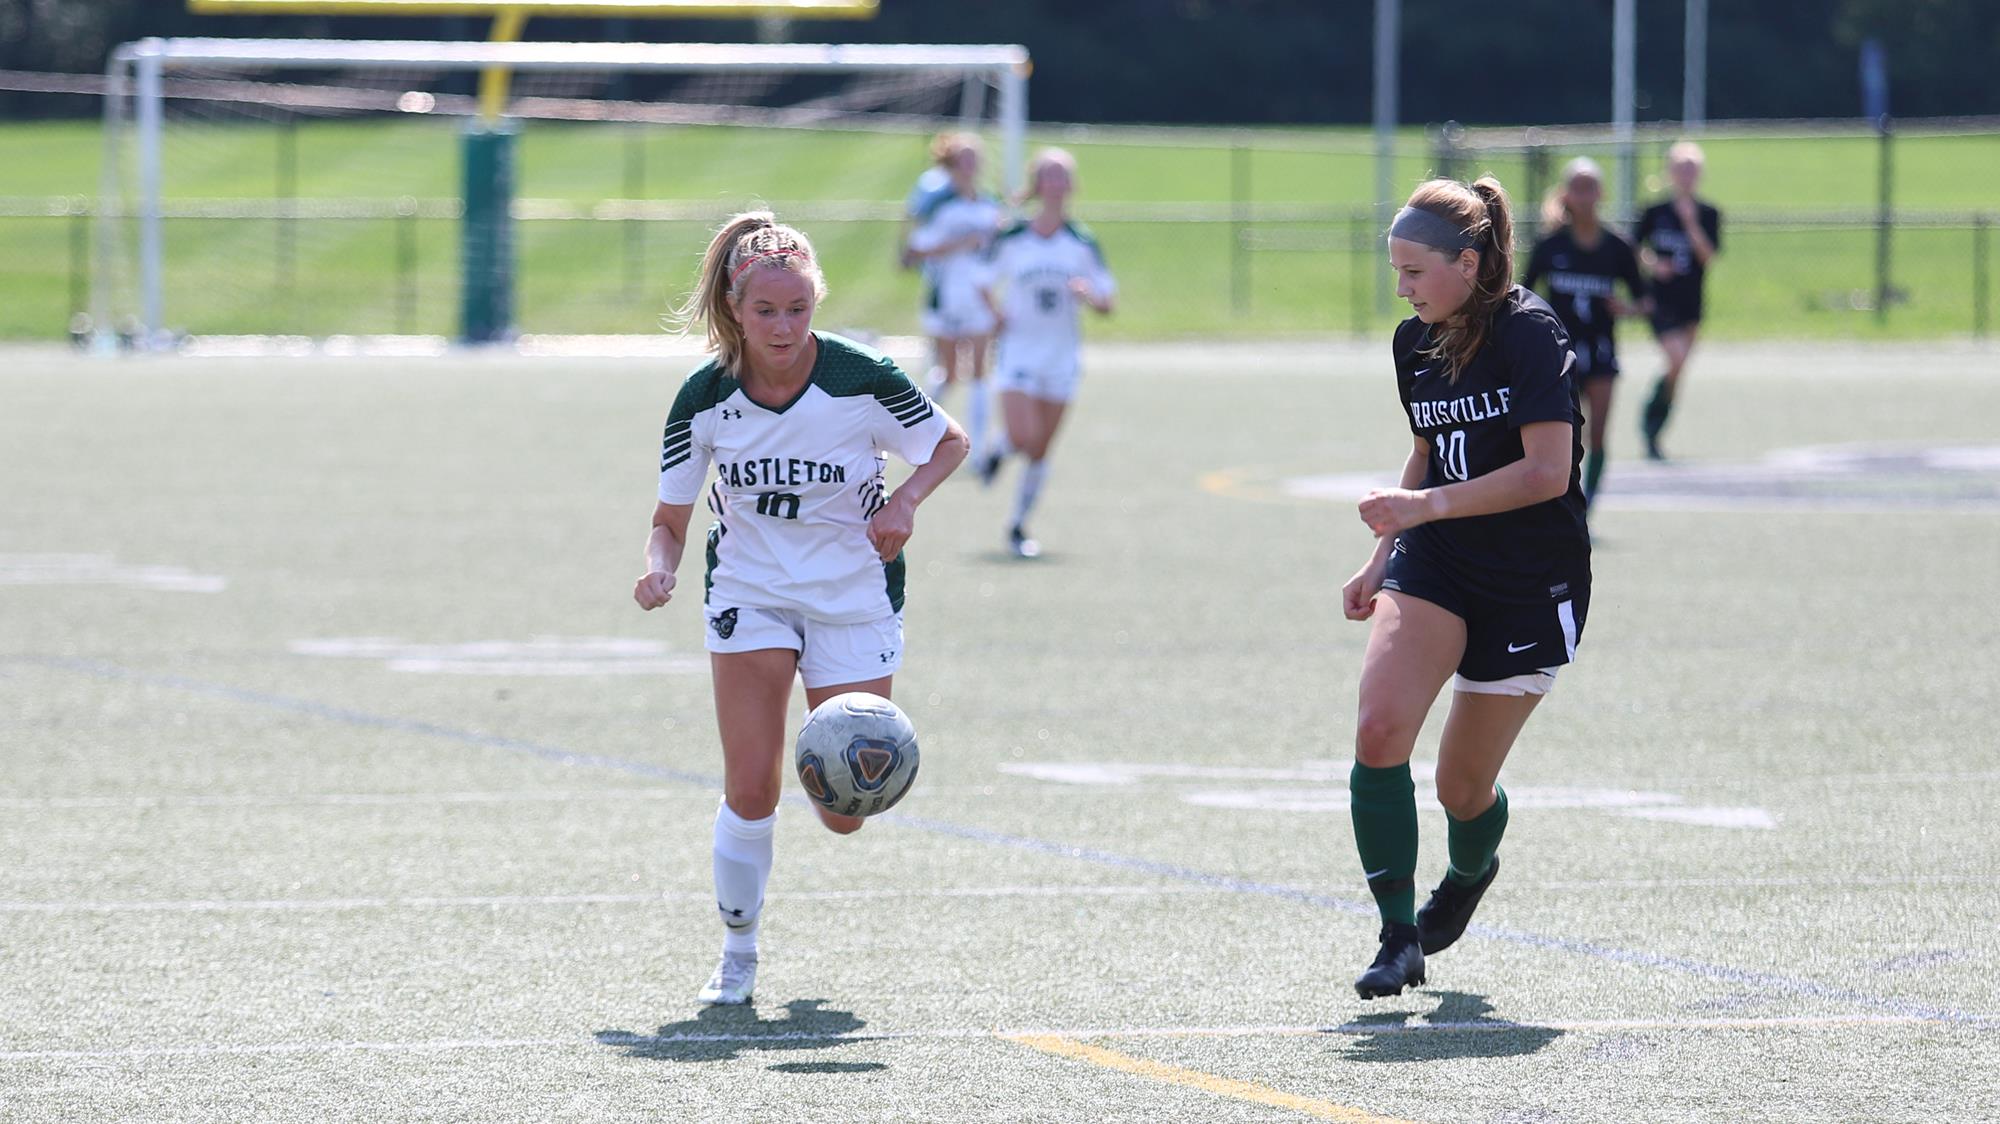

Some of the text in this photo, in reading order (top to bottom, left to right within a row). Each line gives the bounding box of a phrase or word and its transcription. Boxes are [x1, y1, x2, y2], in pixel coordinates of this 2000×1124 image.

[1410, 387, 1510, 428] RRISVILLE
[719, 458, 845, 488] CASTLETON
[1435, 430, 1468, 481] 10
